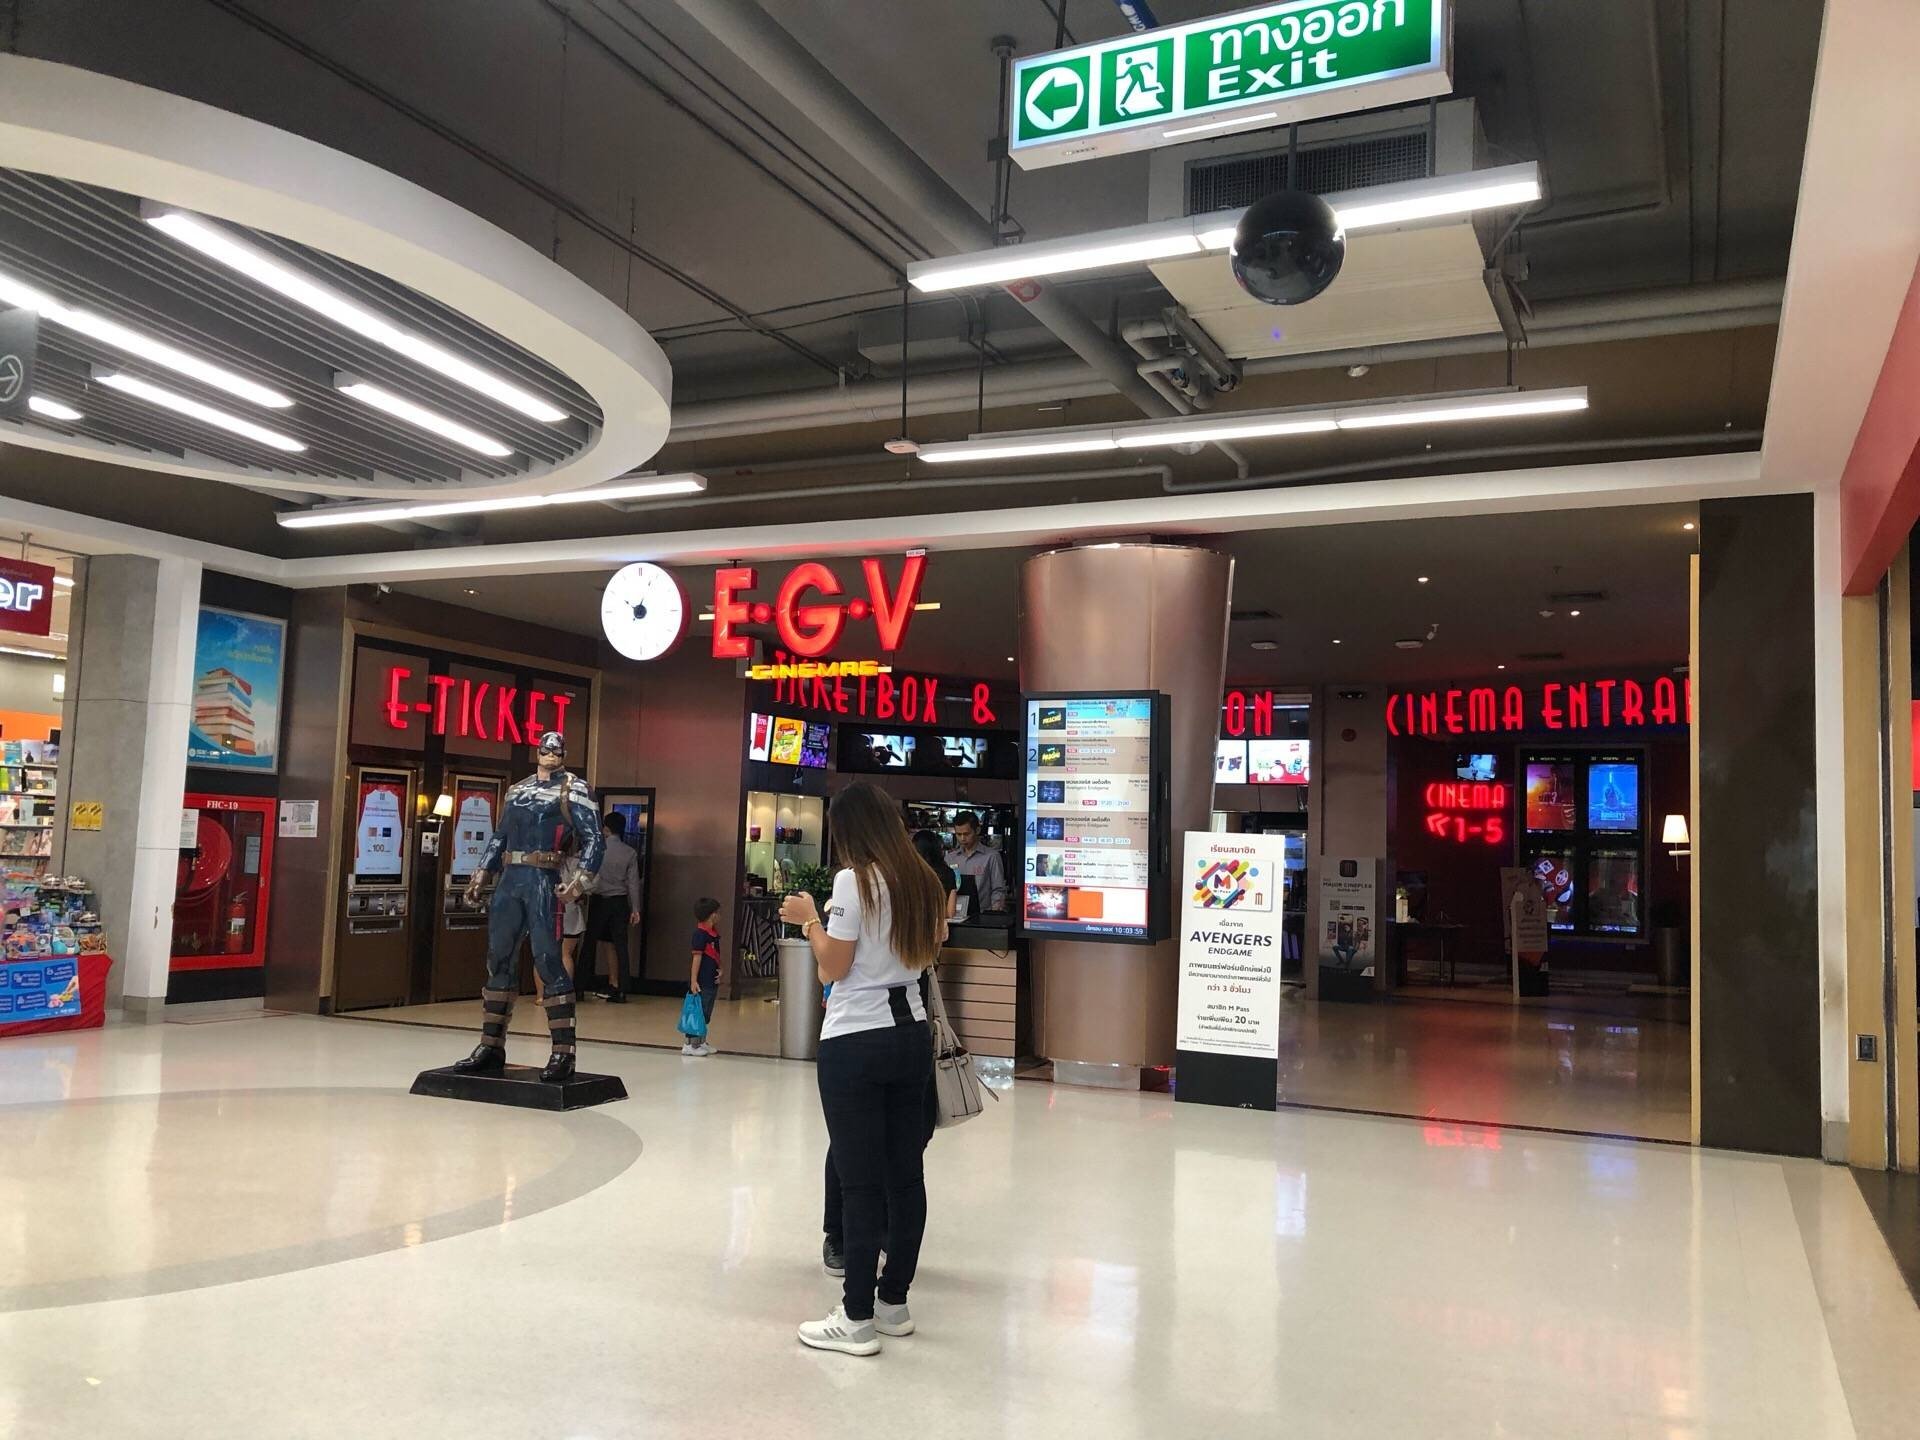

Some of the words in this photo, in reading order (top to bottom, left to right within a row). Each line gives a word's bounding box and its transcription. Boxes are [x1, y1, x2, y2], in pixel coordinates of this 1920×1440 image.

[1209, 0, 1405, 64] ทางออก
[1208, 49, 1338, 101] Exit
[387, 667, 571, 746] E-TICKET
[971, 683, 997, 724] &
[1385, 686, 1524, 737] CINEMA
[1030, 713, 1037, 725] 1
[1028, 748, 1037, 762] 2
[1027, 784, 1037, 798] 3
[1425, 783, 1506, 809] CINEMA
[206, 800, 239, 810] FHC-19
[1026, 821, 1036, 835] 4
[1454, 817, 1504, 843] 1-5
[372, 843, 385, 853] 100
[467, 847, 478, 855] 100
[1026, 857, 1035, 872] 5
[1190, 931, 1273, 947] AVENGERS
[1208, 947, 1253, 957] ENDGAME
[1234, 1015, 1247, 1024] 20
